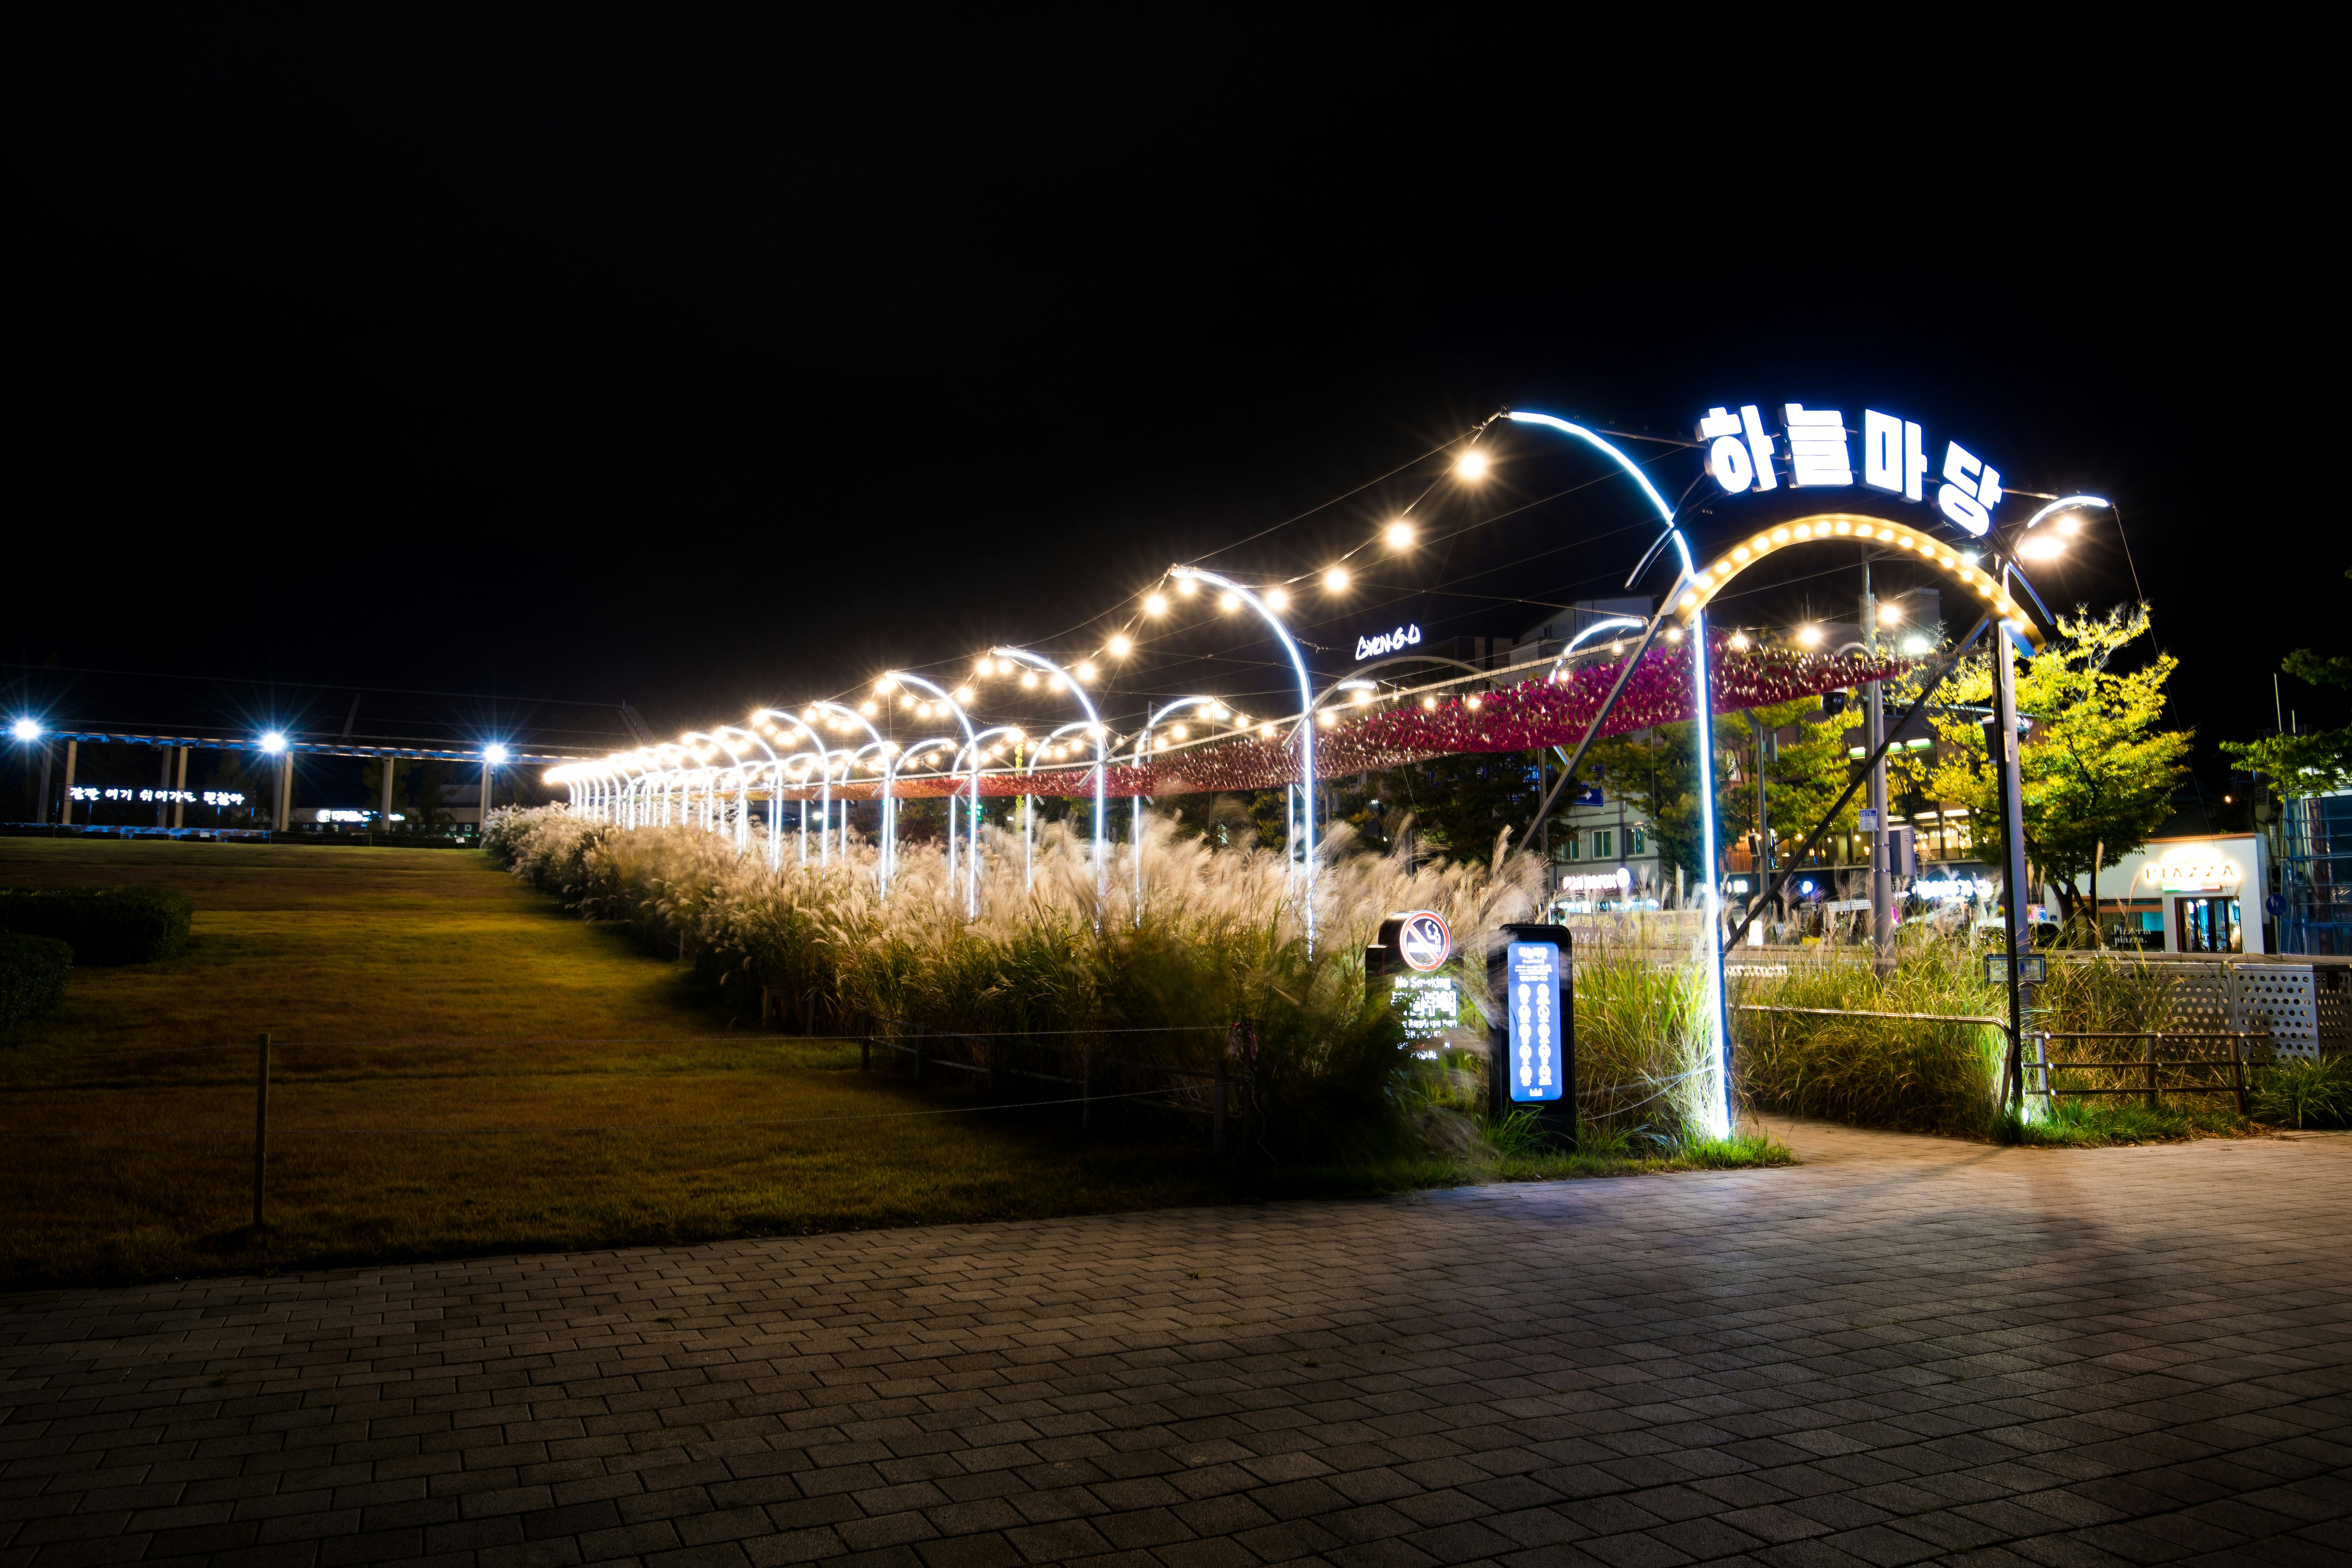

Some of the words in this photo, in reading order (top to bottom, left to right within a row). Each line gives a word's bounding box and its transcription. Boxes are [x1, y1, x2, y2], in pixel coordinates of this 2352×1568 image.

[1695, 403, 2003, 536] 하늘마당
[70, 787, 101, 801] 잠깐
[105, 788, 132, 801] 여기
[140, 789, 197, 803] 쉬어가도
[204, 792, 245, 806] 괜찮아
[2145, 865, 2234, 879] PIAZZA
[2111, 924, 2151, 935] Pizzeria
[1395, 976, 1409, 988] No
[1410, 975, 1452, 990] Smoking
